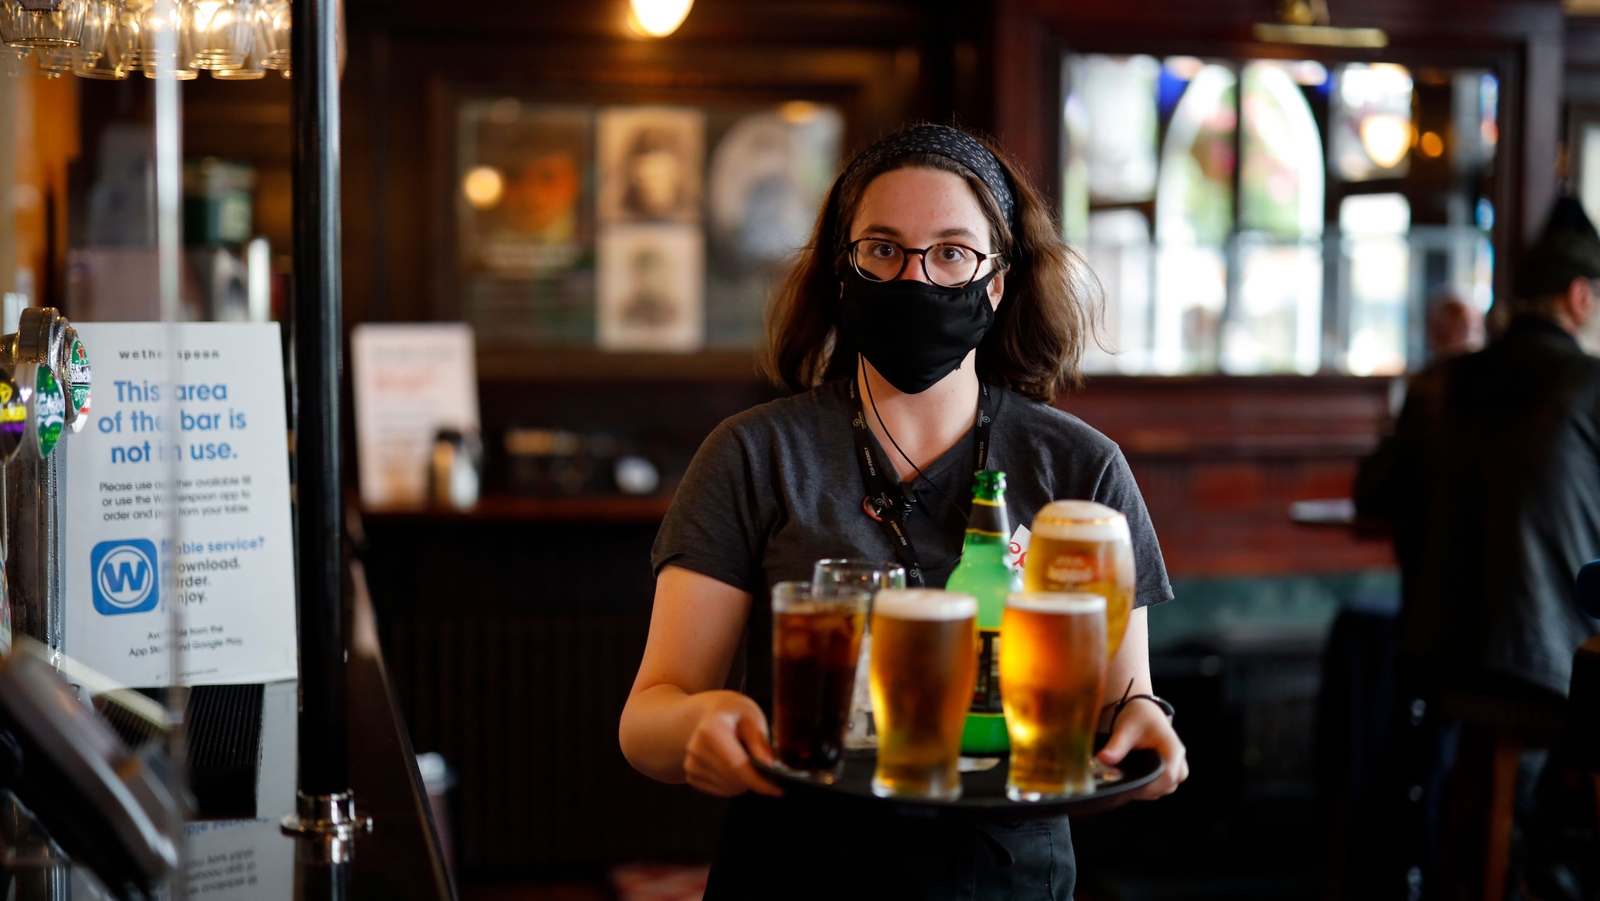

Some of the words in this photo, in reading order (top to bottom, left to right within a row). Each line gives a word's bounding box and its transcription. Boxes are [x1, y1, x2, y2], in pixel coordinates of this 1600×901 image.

[113, 380, 160, 402] This
[173, 383, 228, 401] area
[98, 410, 122, 433] of
[180, 408, 221, 431] bar
[228, 407, 247, 430] is
[111, 440, 151, 463] not
[190, 442, 238, 461] use.
[864, 447, 876, 476] ECO-FRIENDLY
[99, 481, 133, 492] Please
[135, 481, 152, 490] use
[102, 498, 113, 507] or
[115, 496, 133, 506] use
[135, 494, 151, 504] the
[103, 510, 131, 522] order
[132, 508, 153, 520] and
[207, 536, 265, 551] service?
[174, 556, 242, 574] ownload.
[103, 560, 148, 593] W
[177, 590, 208, 606] njoy.
[129, 646, 148, 658] App
